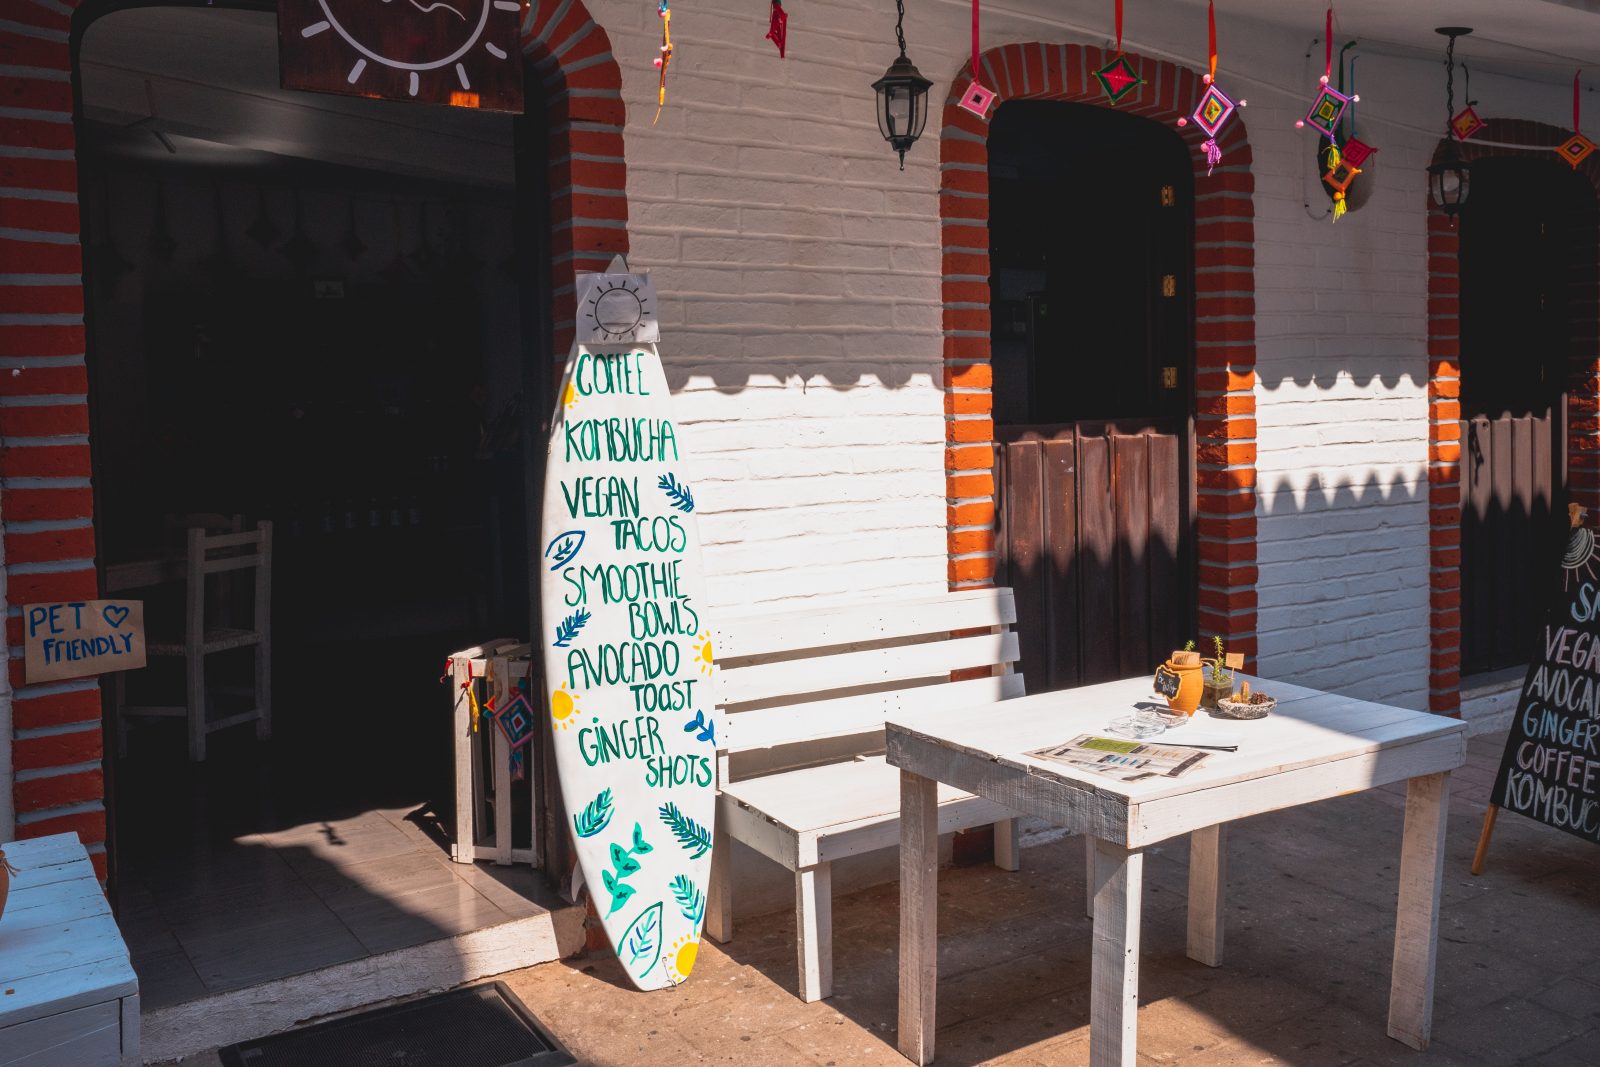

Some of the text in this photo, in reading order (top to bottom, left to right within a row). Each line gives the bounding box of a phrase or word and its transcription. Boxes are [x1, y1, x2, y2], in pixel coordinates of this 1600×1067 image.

[576, 353, 650, 396] COFFEE
[565, 417, 679, 462] KOMBUCHA
[560, 476, 640, 519] VEGAN
[610, 515, 687, 552] TACOS
[563, 559, 688, 607] SMOOTHIE
[29, 602, 86, 638] PET
[628, 598, 699, 641] BOWLS
[567, 640, 680, 690] AVOCADO
[1522, 701, 1600, 756] GINGER
[645, 754, 713, 788] SHOTS
[1516, 740, 1600, 794] COFFEE
[1503, 767, 1600, 841] KOMBUC
